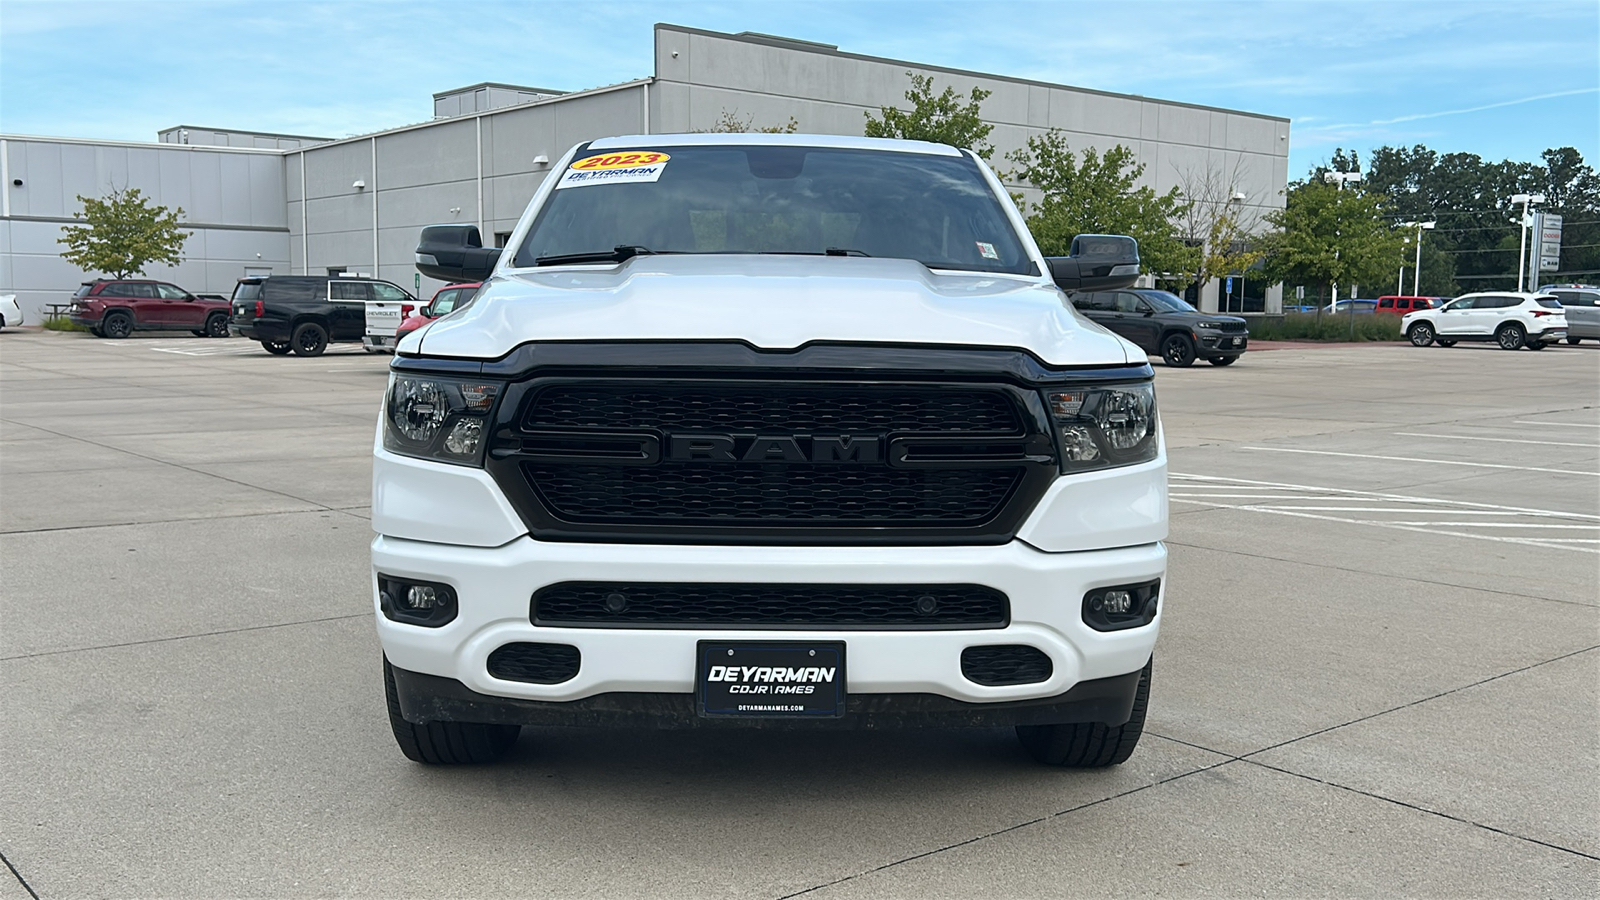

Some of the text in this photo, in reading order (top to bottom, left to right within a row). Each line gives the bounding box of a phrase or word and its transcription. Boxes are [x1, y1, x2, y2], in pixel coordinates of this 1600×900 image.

[579, 154, 661, 169] 2023
[568, 168, 658, 180] DEYARMAN
[671, 434, 879, 461] RAM
[707, 665, 836, 683] DEYARMAN
[774, 685, 815, 694] AMES
[738, 704, 804, 712] DEYARMANAMES.COM
